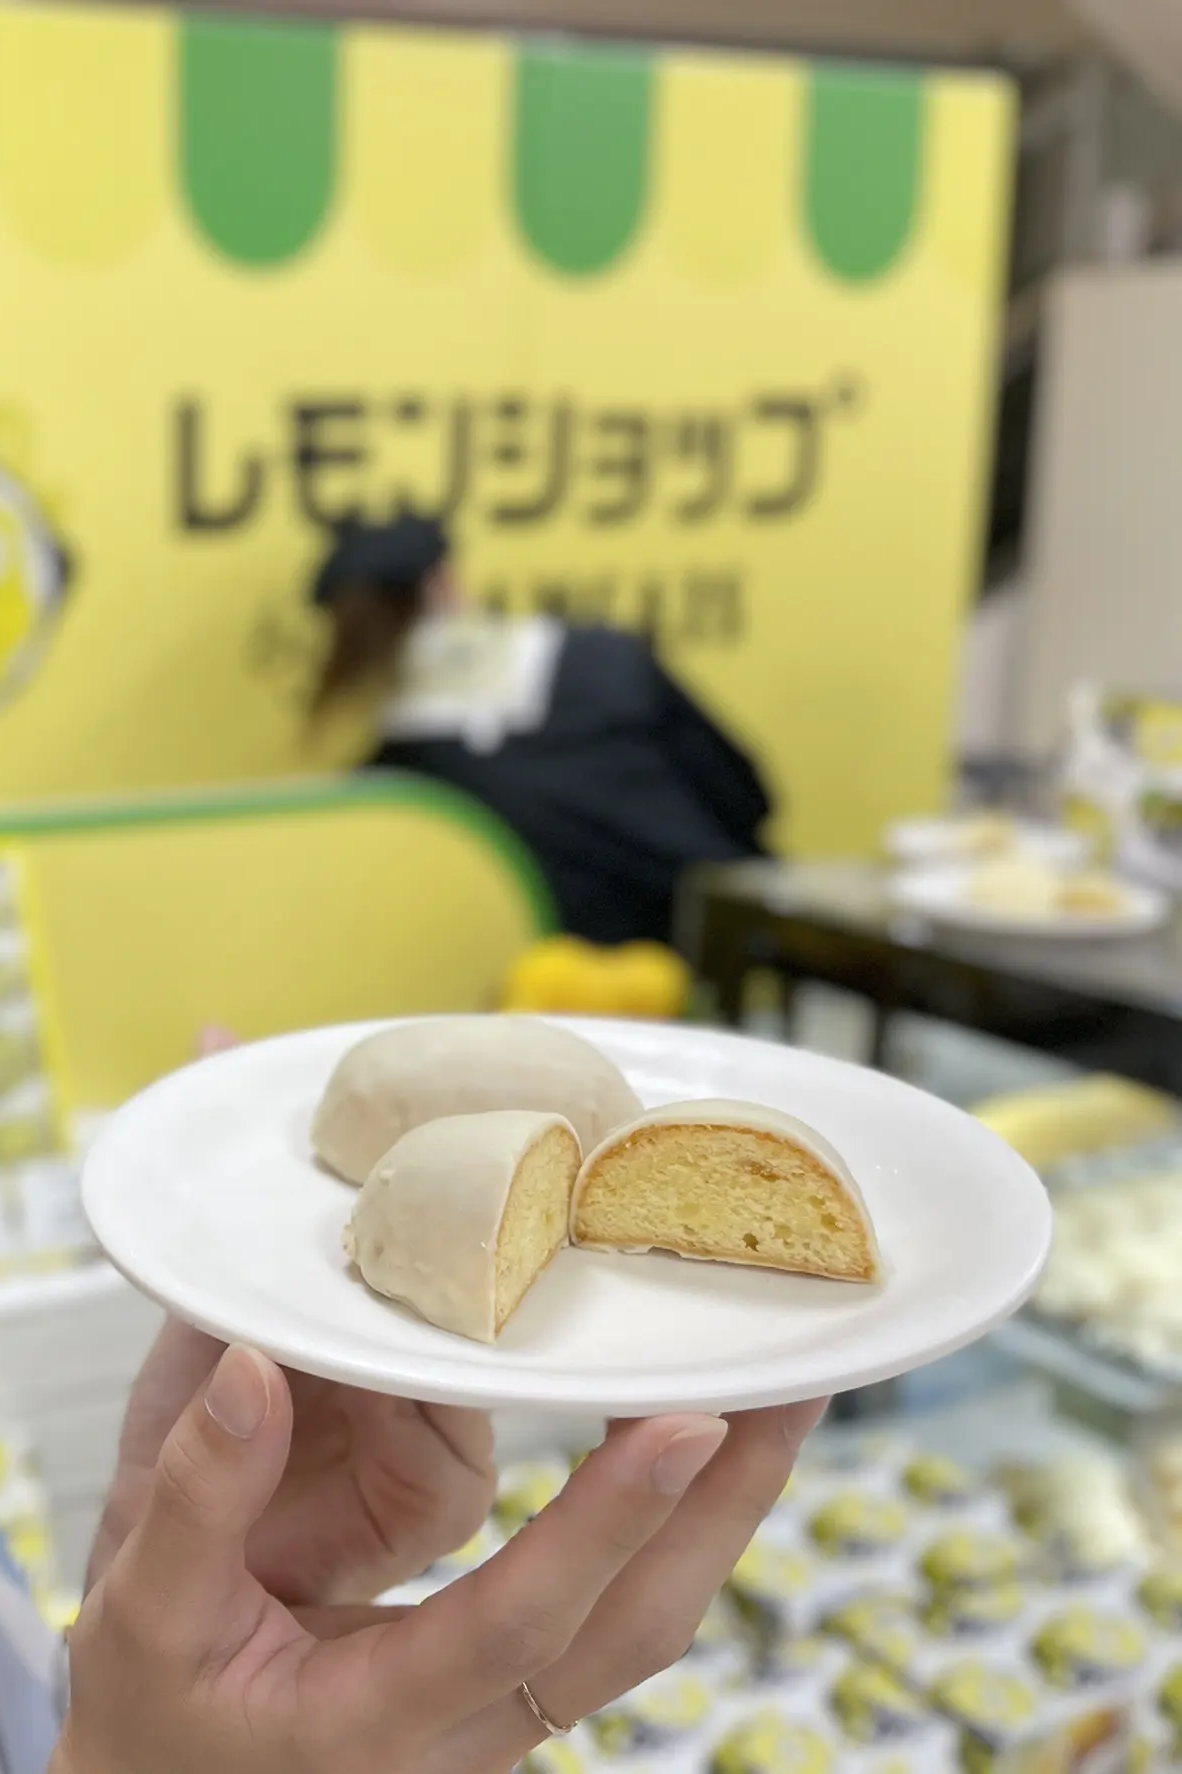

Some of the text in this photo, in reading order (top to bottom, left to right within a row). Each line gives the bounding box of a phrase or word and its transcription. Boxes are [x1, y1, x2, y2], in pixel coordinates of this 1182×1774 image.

[175, 376, 858, 534] レモンショップ
